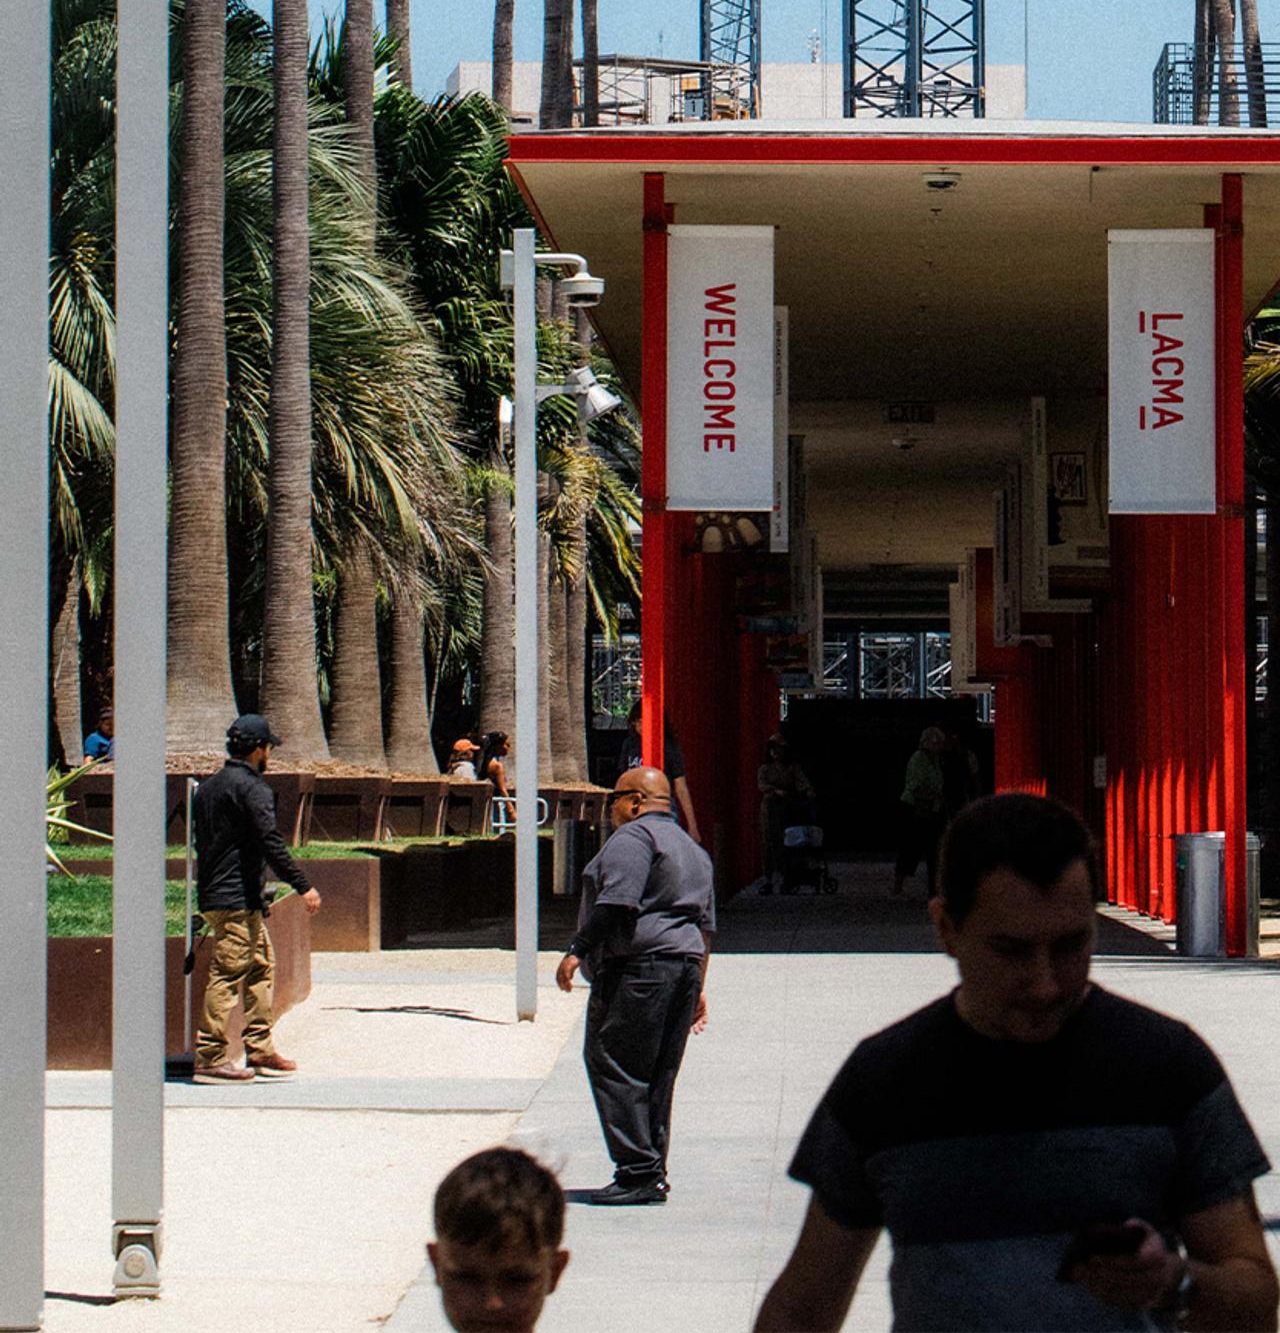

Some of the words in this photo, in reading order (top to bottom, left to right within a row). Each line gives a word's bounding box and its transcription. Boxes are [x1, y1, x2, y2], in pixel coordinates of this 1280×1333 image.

[691, 100, 696, 112] 1
[704, 283, 736, 453] WELCOME
[1140, 311, 1184, 430] LACMA
[889, 404, 926, 420] EXIT
